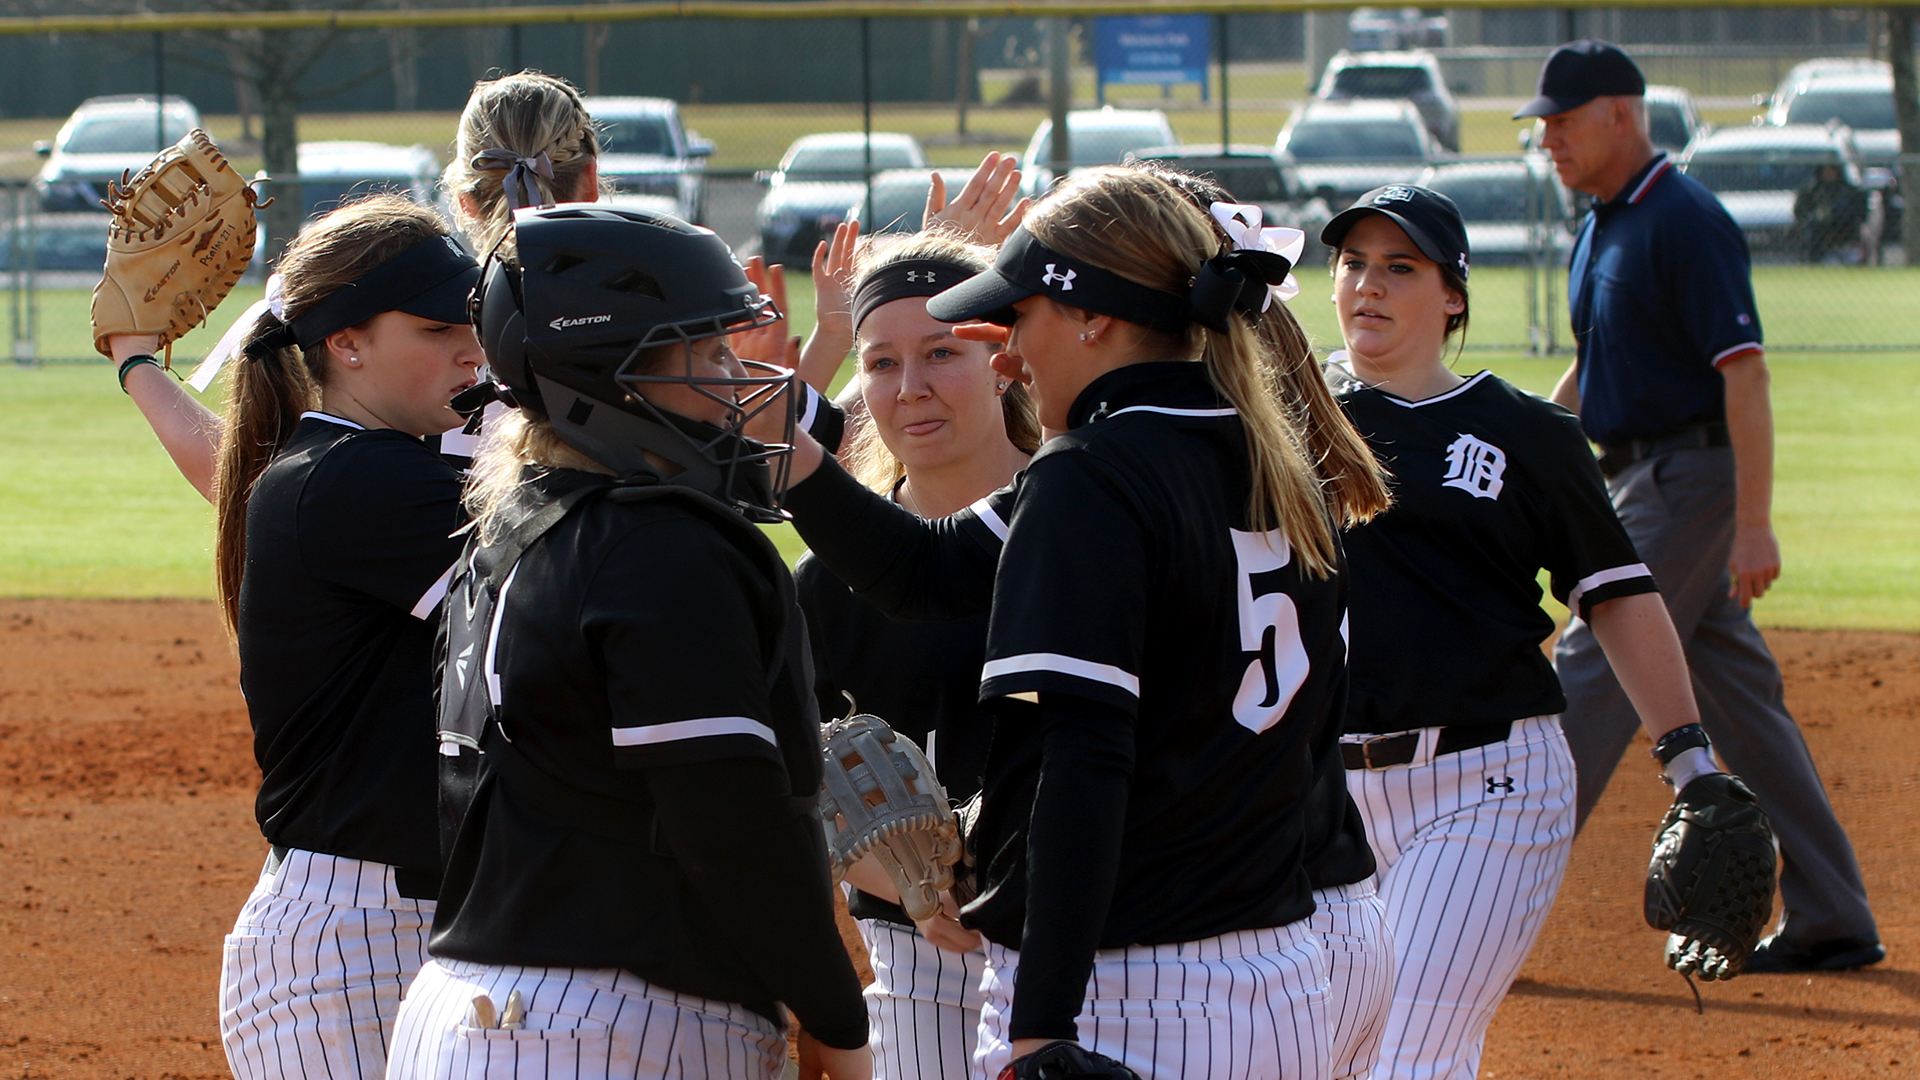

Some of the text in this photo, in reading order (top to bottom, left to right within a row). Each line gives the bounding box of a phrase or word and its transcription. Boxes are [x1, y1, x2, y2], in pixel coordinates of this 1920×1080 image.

[199, 241, 223, 267] Psalm
[152, 259, 181, 296] EASTON
[562, 314, 611, 328] EASTON
[1229, 527, 1310, 735] 5
